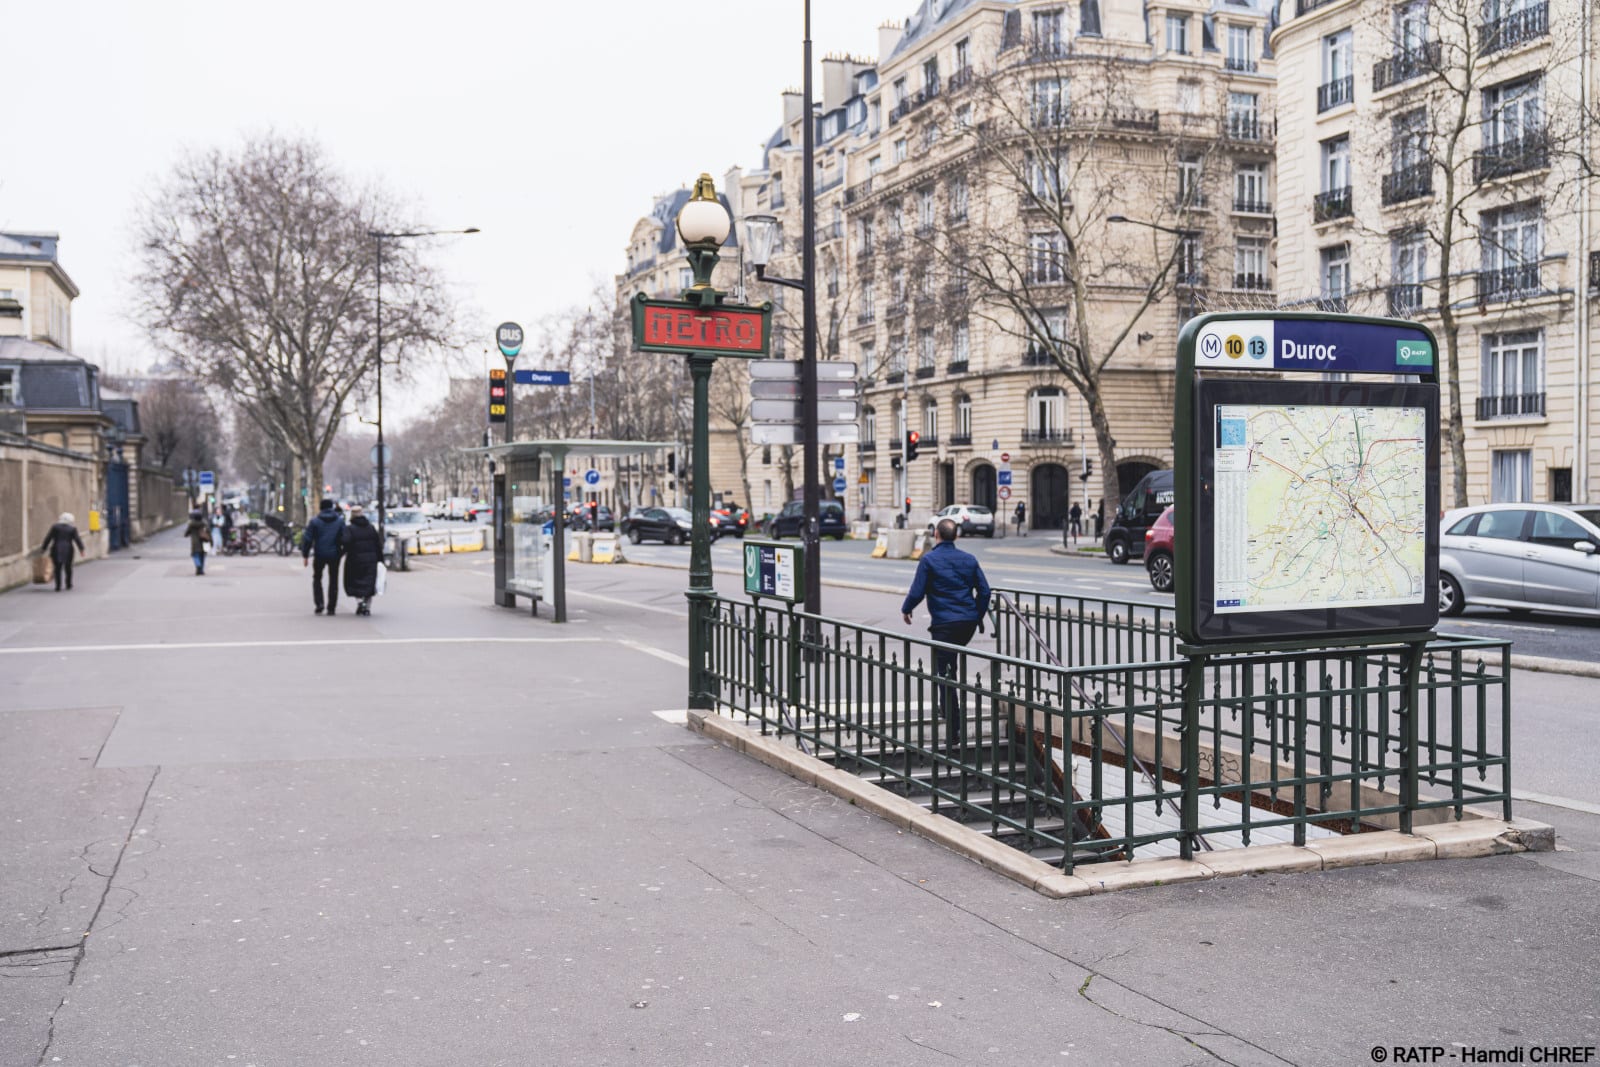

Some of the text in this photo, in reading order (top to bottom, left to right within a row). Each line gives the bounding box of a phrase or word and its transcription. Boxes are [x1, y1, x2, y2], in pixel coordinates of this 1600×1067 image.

[500, 328, 521, 341] BUS
[653, 312, 755, 344] METRO
[1206, 339, 1265, 355] M 10 13
[1281, 339, 1337, 361] Duroc
